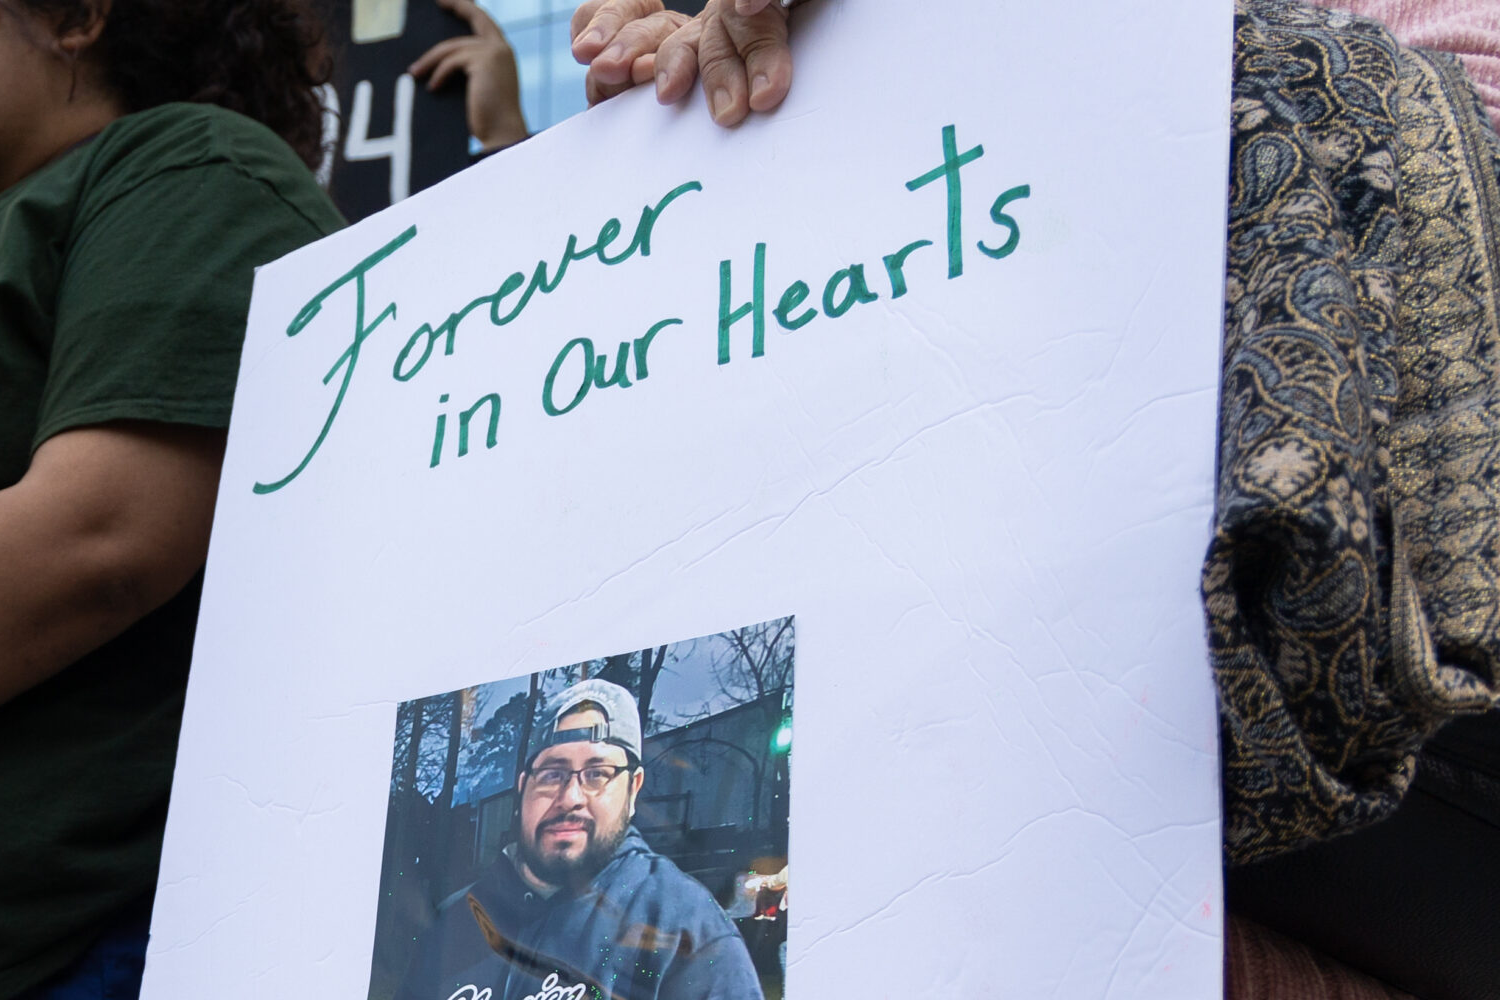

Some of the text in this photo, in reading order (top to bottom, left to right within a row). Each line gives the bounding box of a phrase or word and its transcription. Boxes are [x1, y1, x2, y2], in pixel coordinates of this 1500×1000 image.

[253, 180, 703, 496] Forever
[429, 392, 501, 469] in
[716, 123, 1032, 367] Hearts
